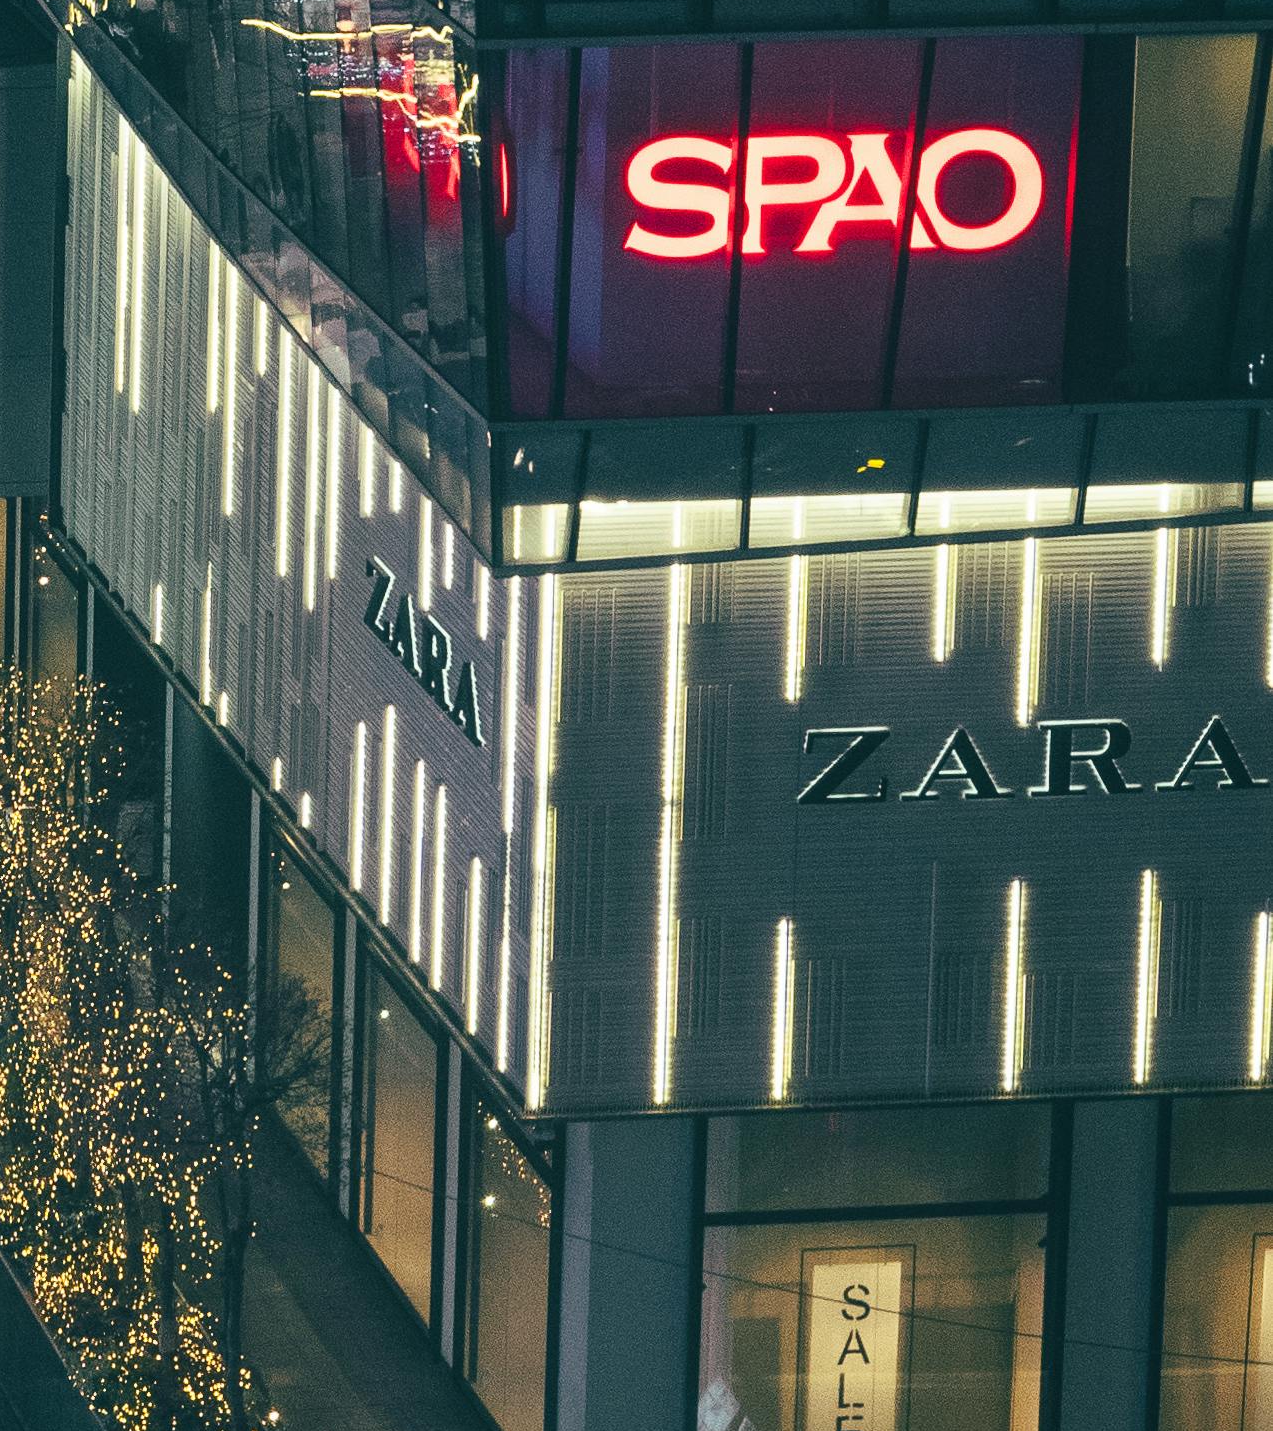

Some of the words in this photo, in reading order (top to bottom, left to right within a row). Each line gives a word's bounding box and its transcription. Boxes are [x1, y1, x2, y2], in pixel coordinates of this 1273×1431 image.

[623, 126, 1045, 259] SPAO
[363, 554, 486, 749] ZARA
[796, 714, 1271, 804] ZARA
